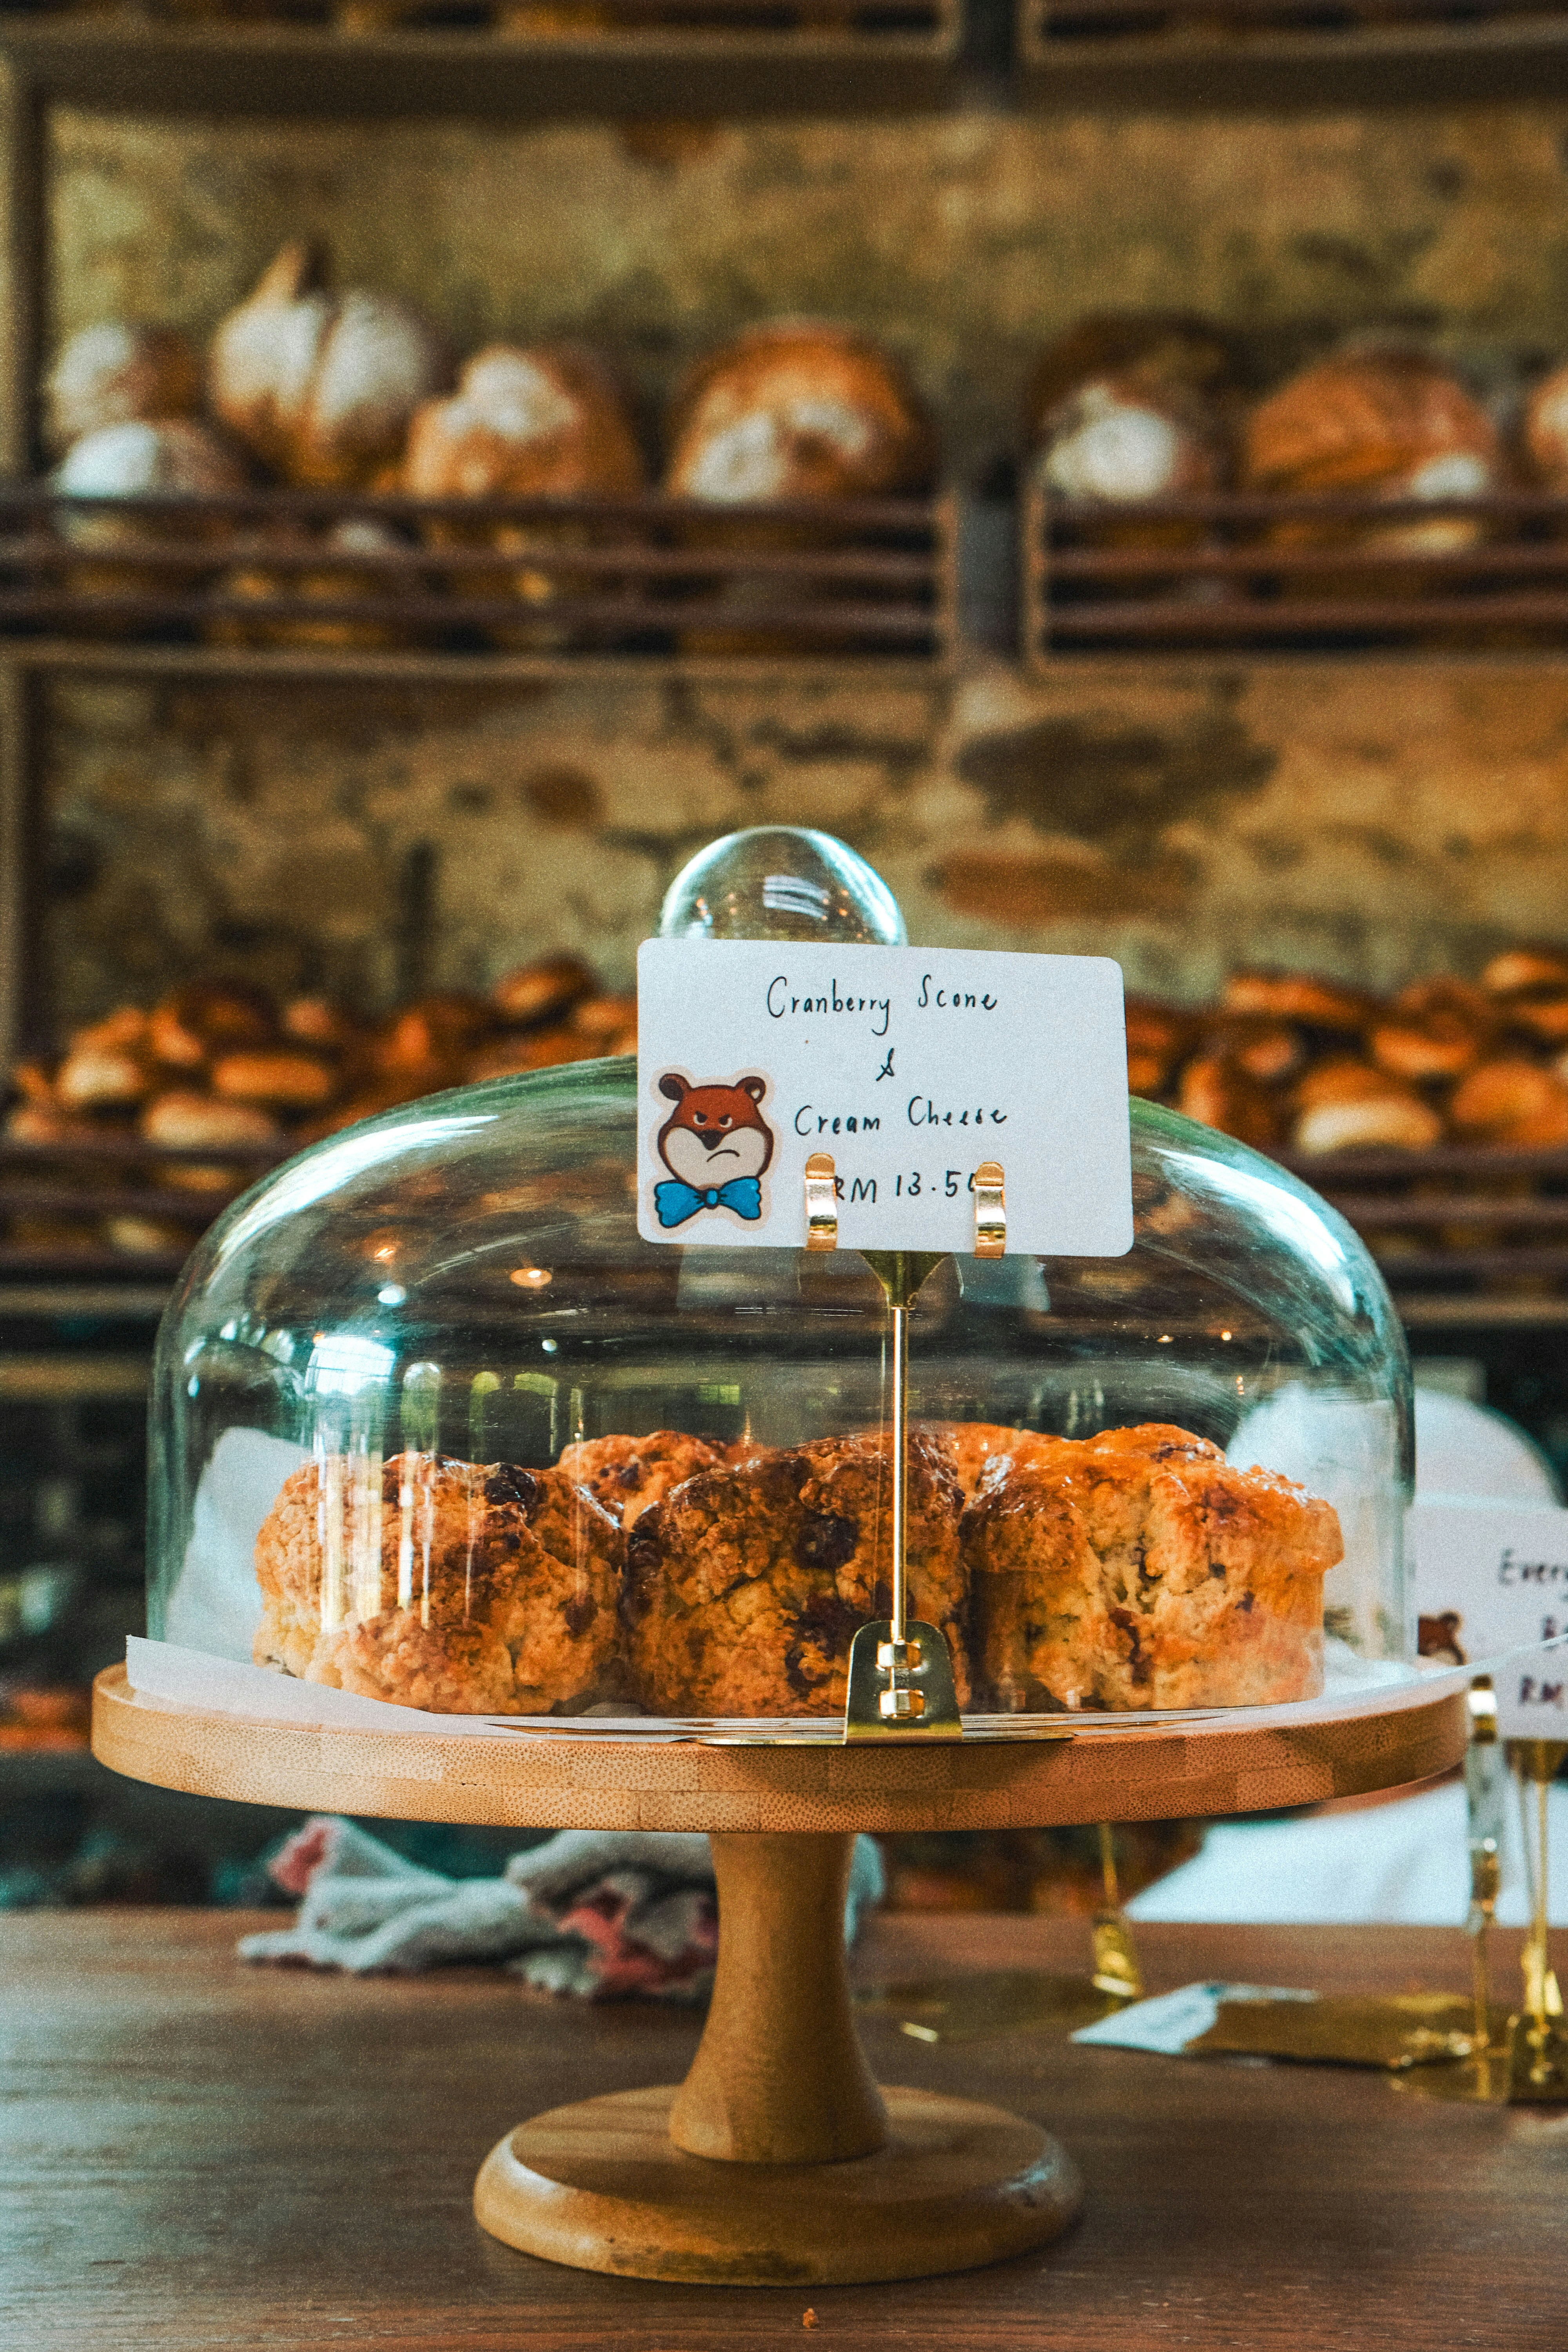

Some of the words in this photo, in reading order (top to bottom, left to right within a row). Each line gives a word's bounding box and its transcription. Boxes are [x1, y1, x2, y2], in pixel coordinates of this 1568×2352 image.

[767, 976, 890, 1036] Cranberry
[918, 974, 997, 1011] Scone
[795, 1105, 880, 1136] Cream
[907, 1095, 1007, 1126] Cheese
[835, 1176, 877, 1203] RM
[1499, 1548, 1568, 1601] Ever
